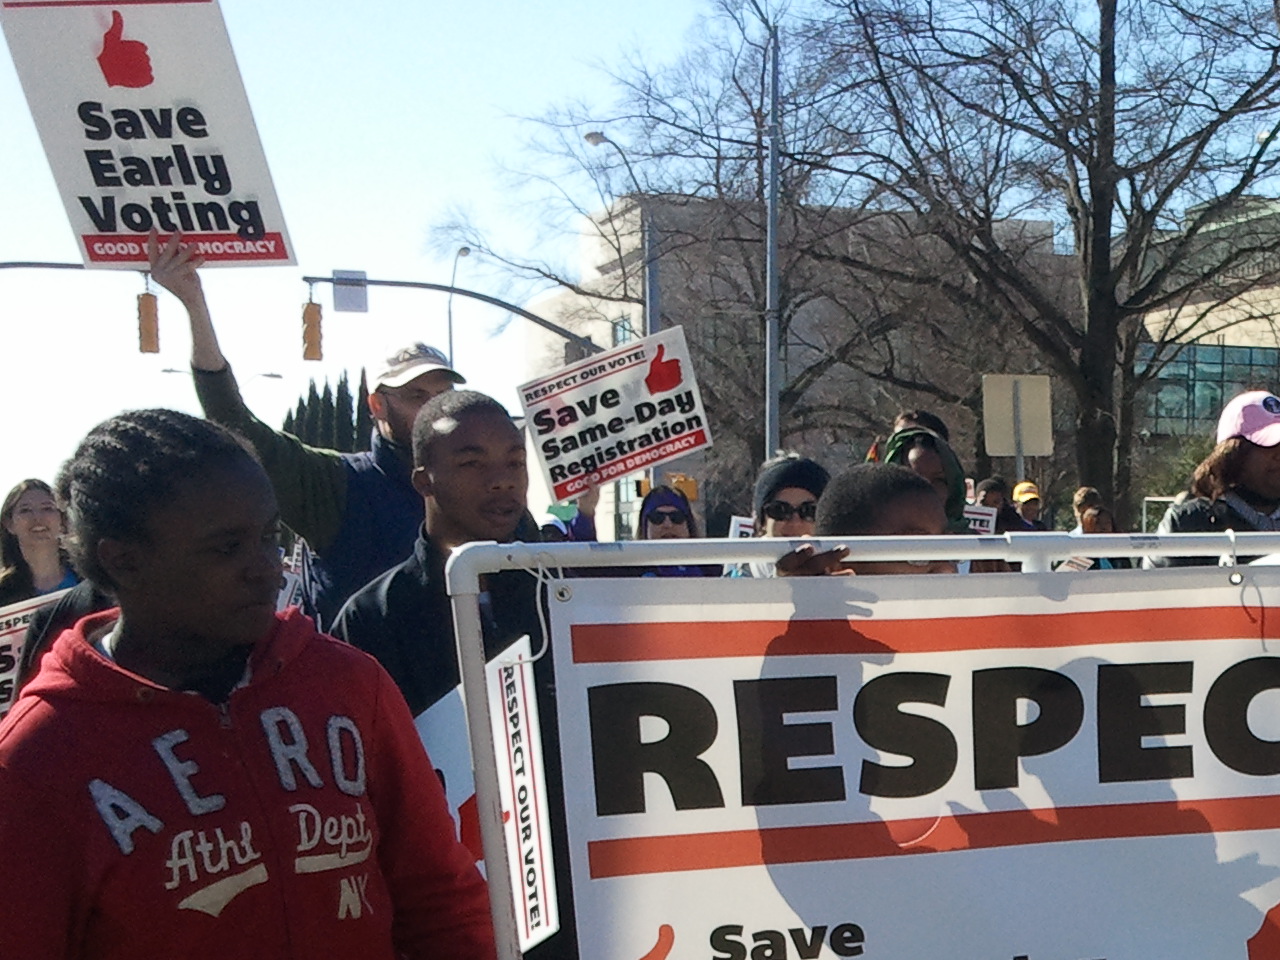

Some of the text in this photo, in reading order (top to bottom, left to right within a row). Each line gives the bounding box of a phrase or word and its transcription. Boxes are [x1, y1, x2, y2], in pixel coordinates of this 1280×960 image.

[77, 101, 208, 140] Save
[84, 145, 232, 195] Early
[78, 192, 265, 241] Voting
[93, 243, 140, 255] GOOD
[179, 240, 276, 255] DMOCRACY
[525, 350, 646, 402] RESPECT OUR VOTE!
[533, 388, 620, 435] Save
[541, 390, 695, 461] Same-Day
[549, 415, 703, 483] Registration
[601, 462, 626, 478] FOR
[626, 435, 697, 468] DEMOCRACY
[503, 666, 541, 930] RESPECT OUR VOTE!
